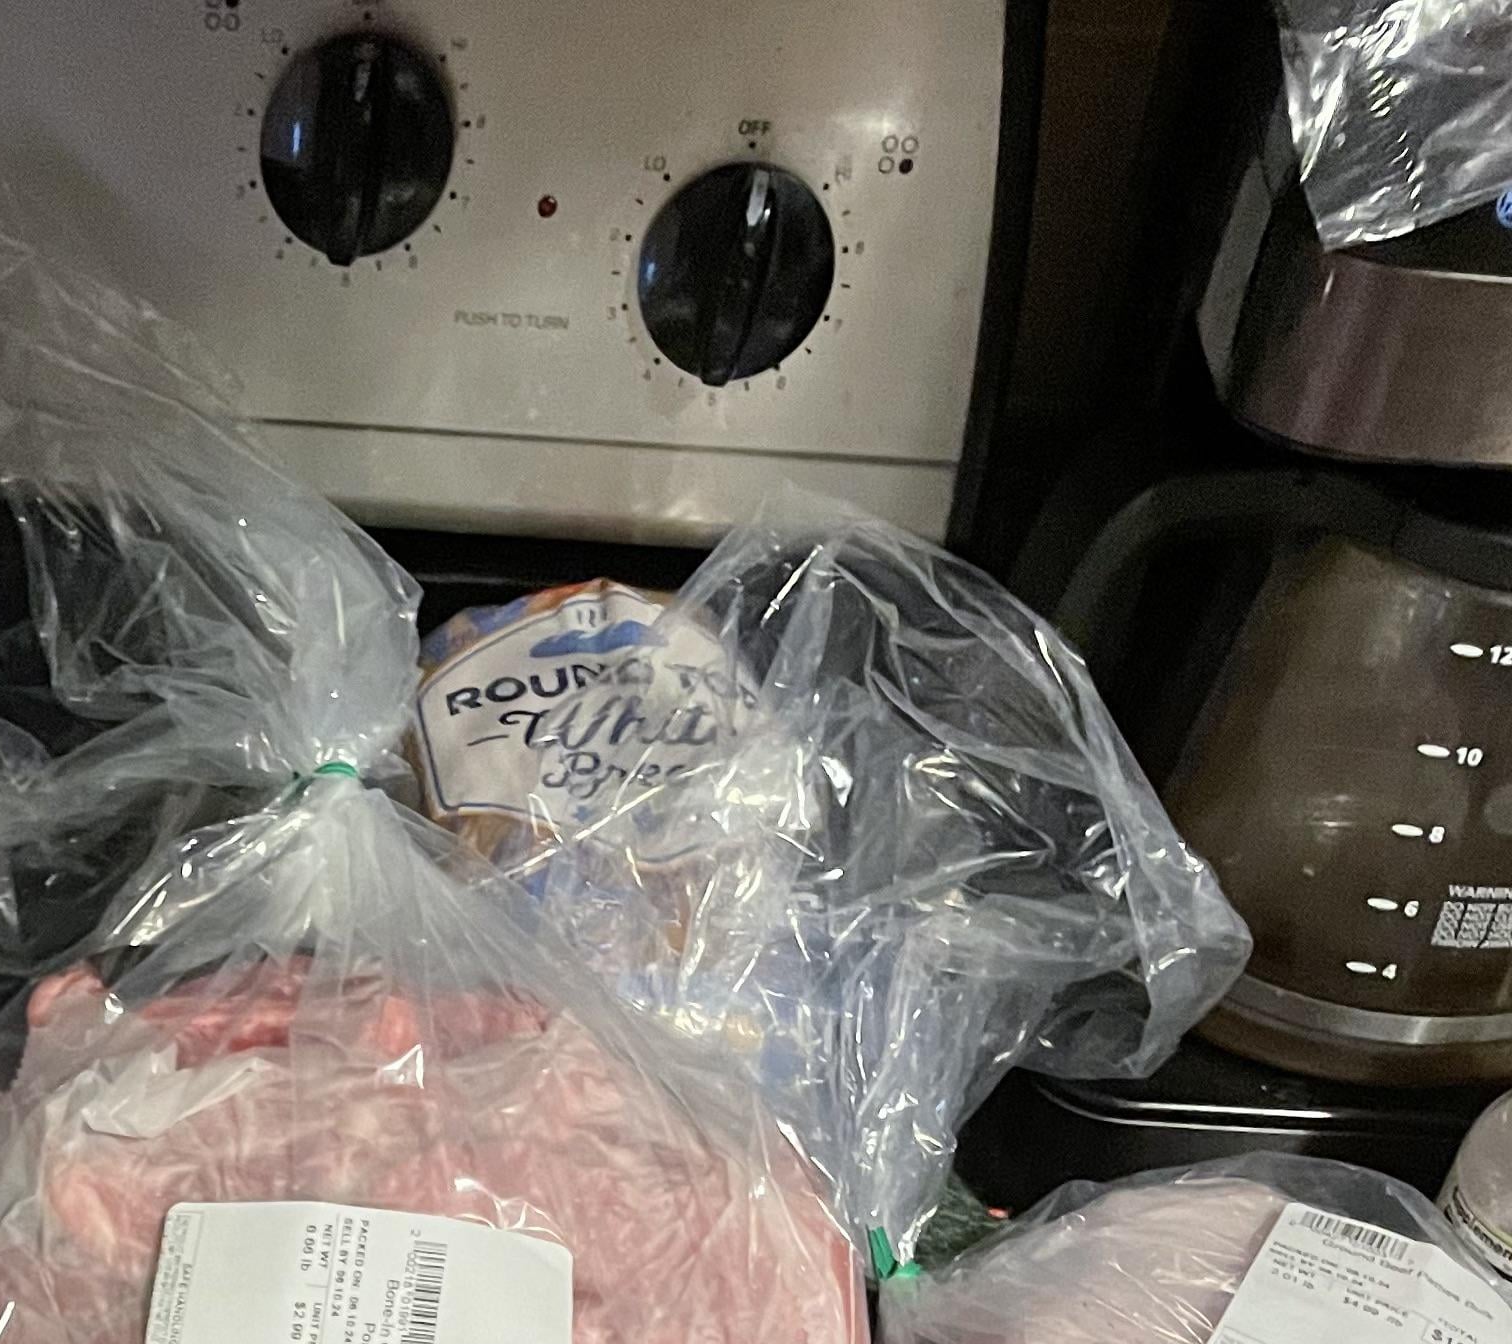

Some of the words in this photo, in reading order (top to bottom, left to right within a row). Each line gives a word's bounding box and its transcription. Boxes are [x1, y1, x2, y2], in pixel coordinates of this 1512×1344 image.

[738, 120, 771, 135] OFF
[1456, 747, 1483, 767] 10
[1429, 826, 1445, 843] 8
[1404, 900, 1419, 918] 6
[1382, 963, 1397, 979] 4
[319, 1224, 332, 1249] NET
[355, 1220, 368, 1266] PACKED
[300, 1258, 313, 1271] lb
[318, 1251, 329, 1269] WT
[338, 1250, 348, 1264] BY
[179, 1263, 192, 1290] SAFE
[310, 1302, 322, 1330] UNIT
[379, 1280, 399, 1337] Bone-In
